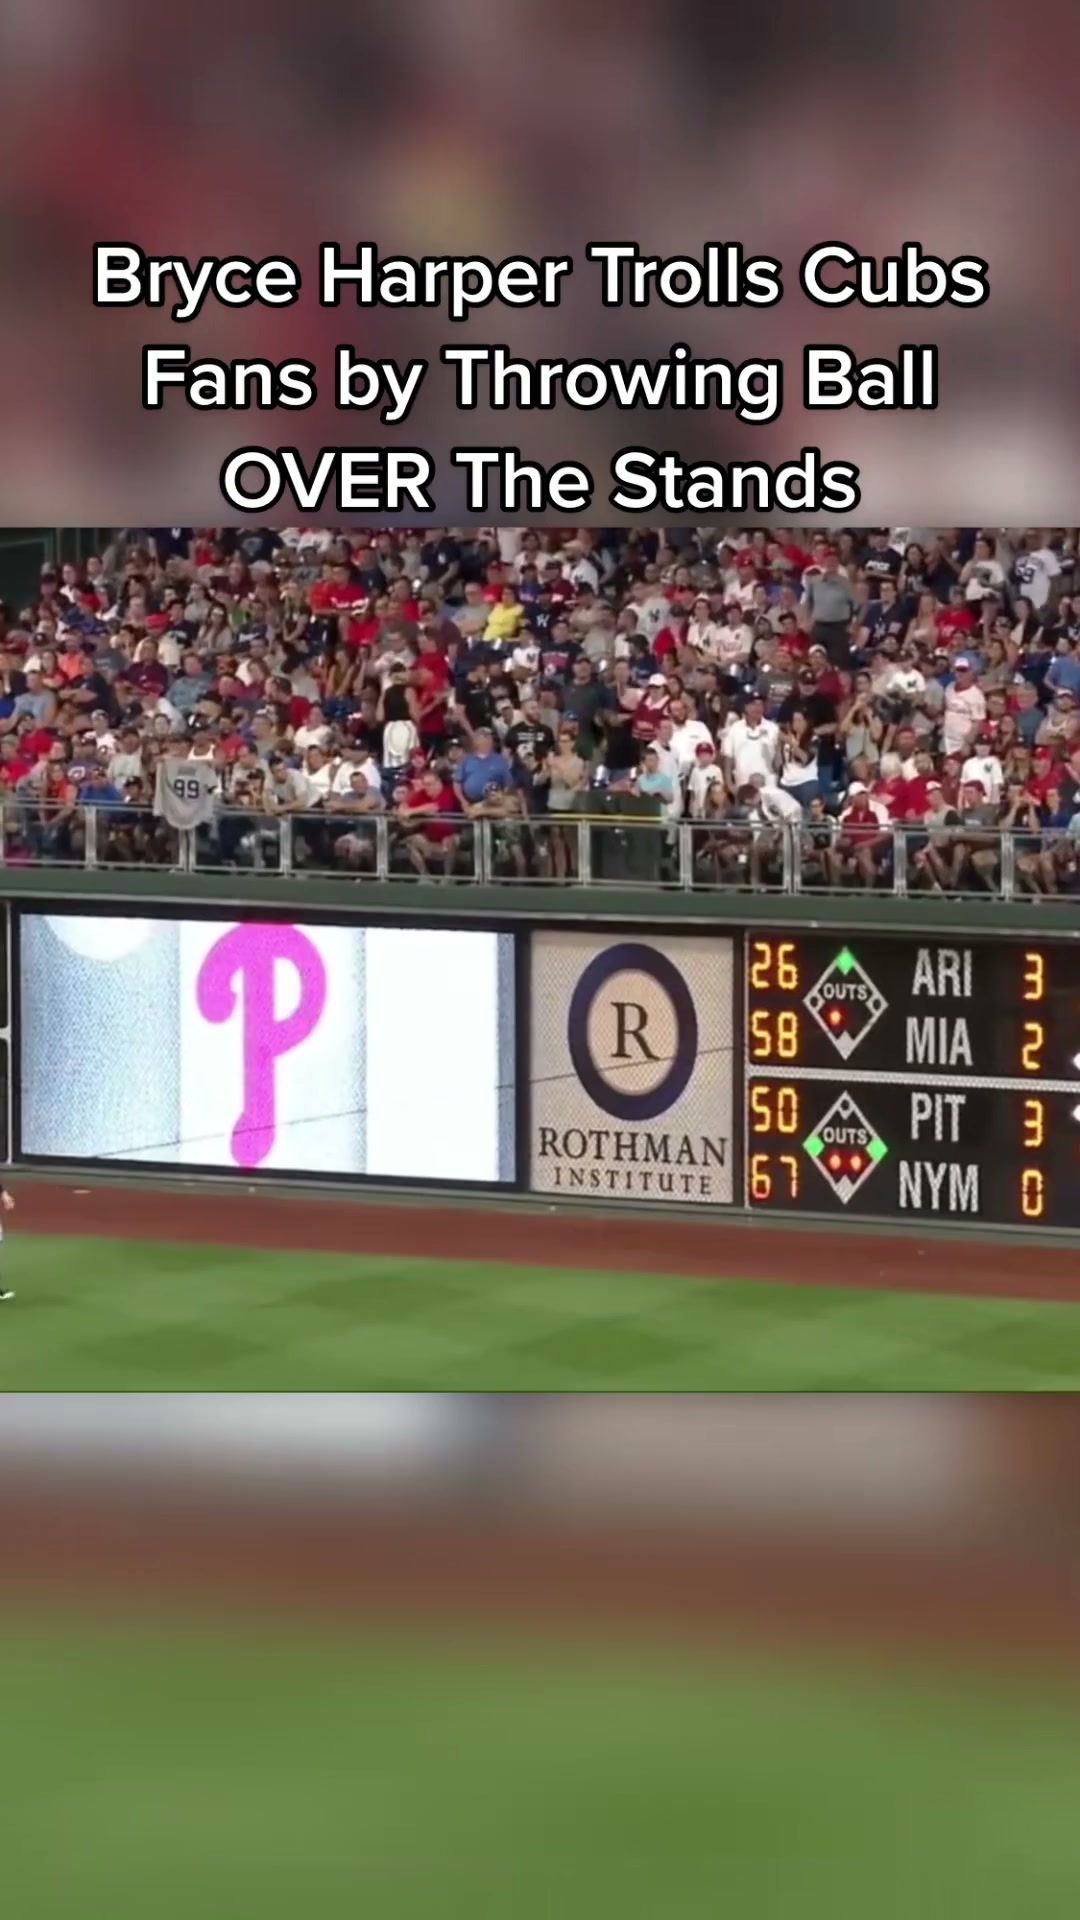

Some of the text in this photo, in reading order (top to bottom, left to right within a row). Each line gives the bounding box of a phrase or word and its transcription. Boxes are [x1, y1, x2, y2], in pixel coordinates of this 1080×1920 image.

[173, 778, 200, 799] 99
[751, 942, 1043, 1000] 26 ARI 3
[823, 983, 868, 1001] OUTS
[610, 1001, 661, 1062] R
[751, 1010, 1043, 1070] 58 MIA 2
[751, 1085, 1043, 1147] 50 PIT 3
[823, 1127, 868, 1145] OUTS
[538, 1126, 729, 1168] ROTHMAN
[553, 1166, 713, 1196] INSTITUTE
[751, 1154, 1043, 1217] 67 NYM 0
